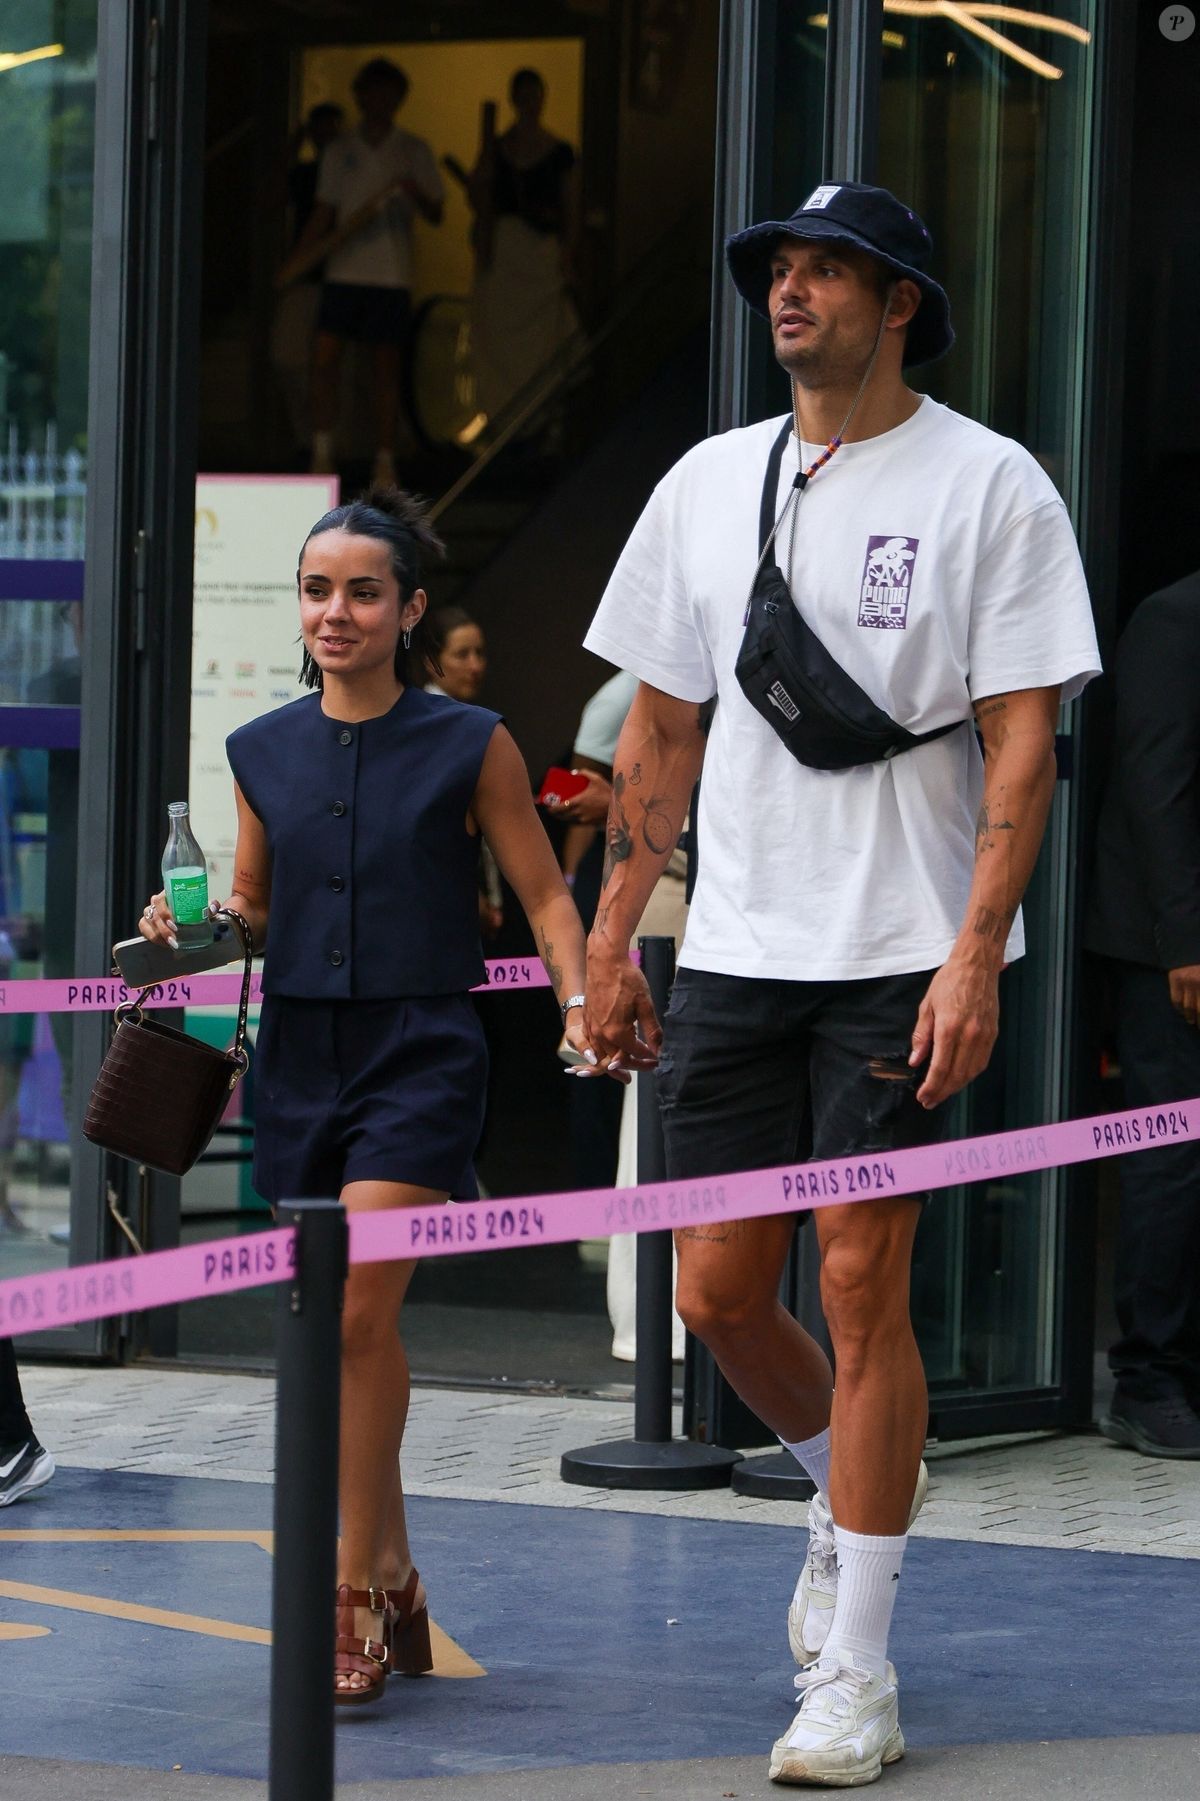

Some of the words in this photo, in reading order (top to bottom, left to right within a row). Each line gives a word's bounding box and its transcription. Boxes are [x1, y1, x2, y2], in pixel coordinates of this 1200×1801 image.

[861, 585, 909, 604] PUMA
[860, 601, 906, 618] BIO
[771, 681, 800, 720] PUMA
[1146, 1111, 1189, 1140] 2024
[845, 1162, 896, 1192] 2024
[485, 1207, 544, 1239] 2024
